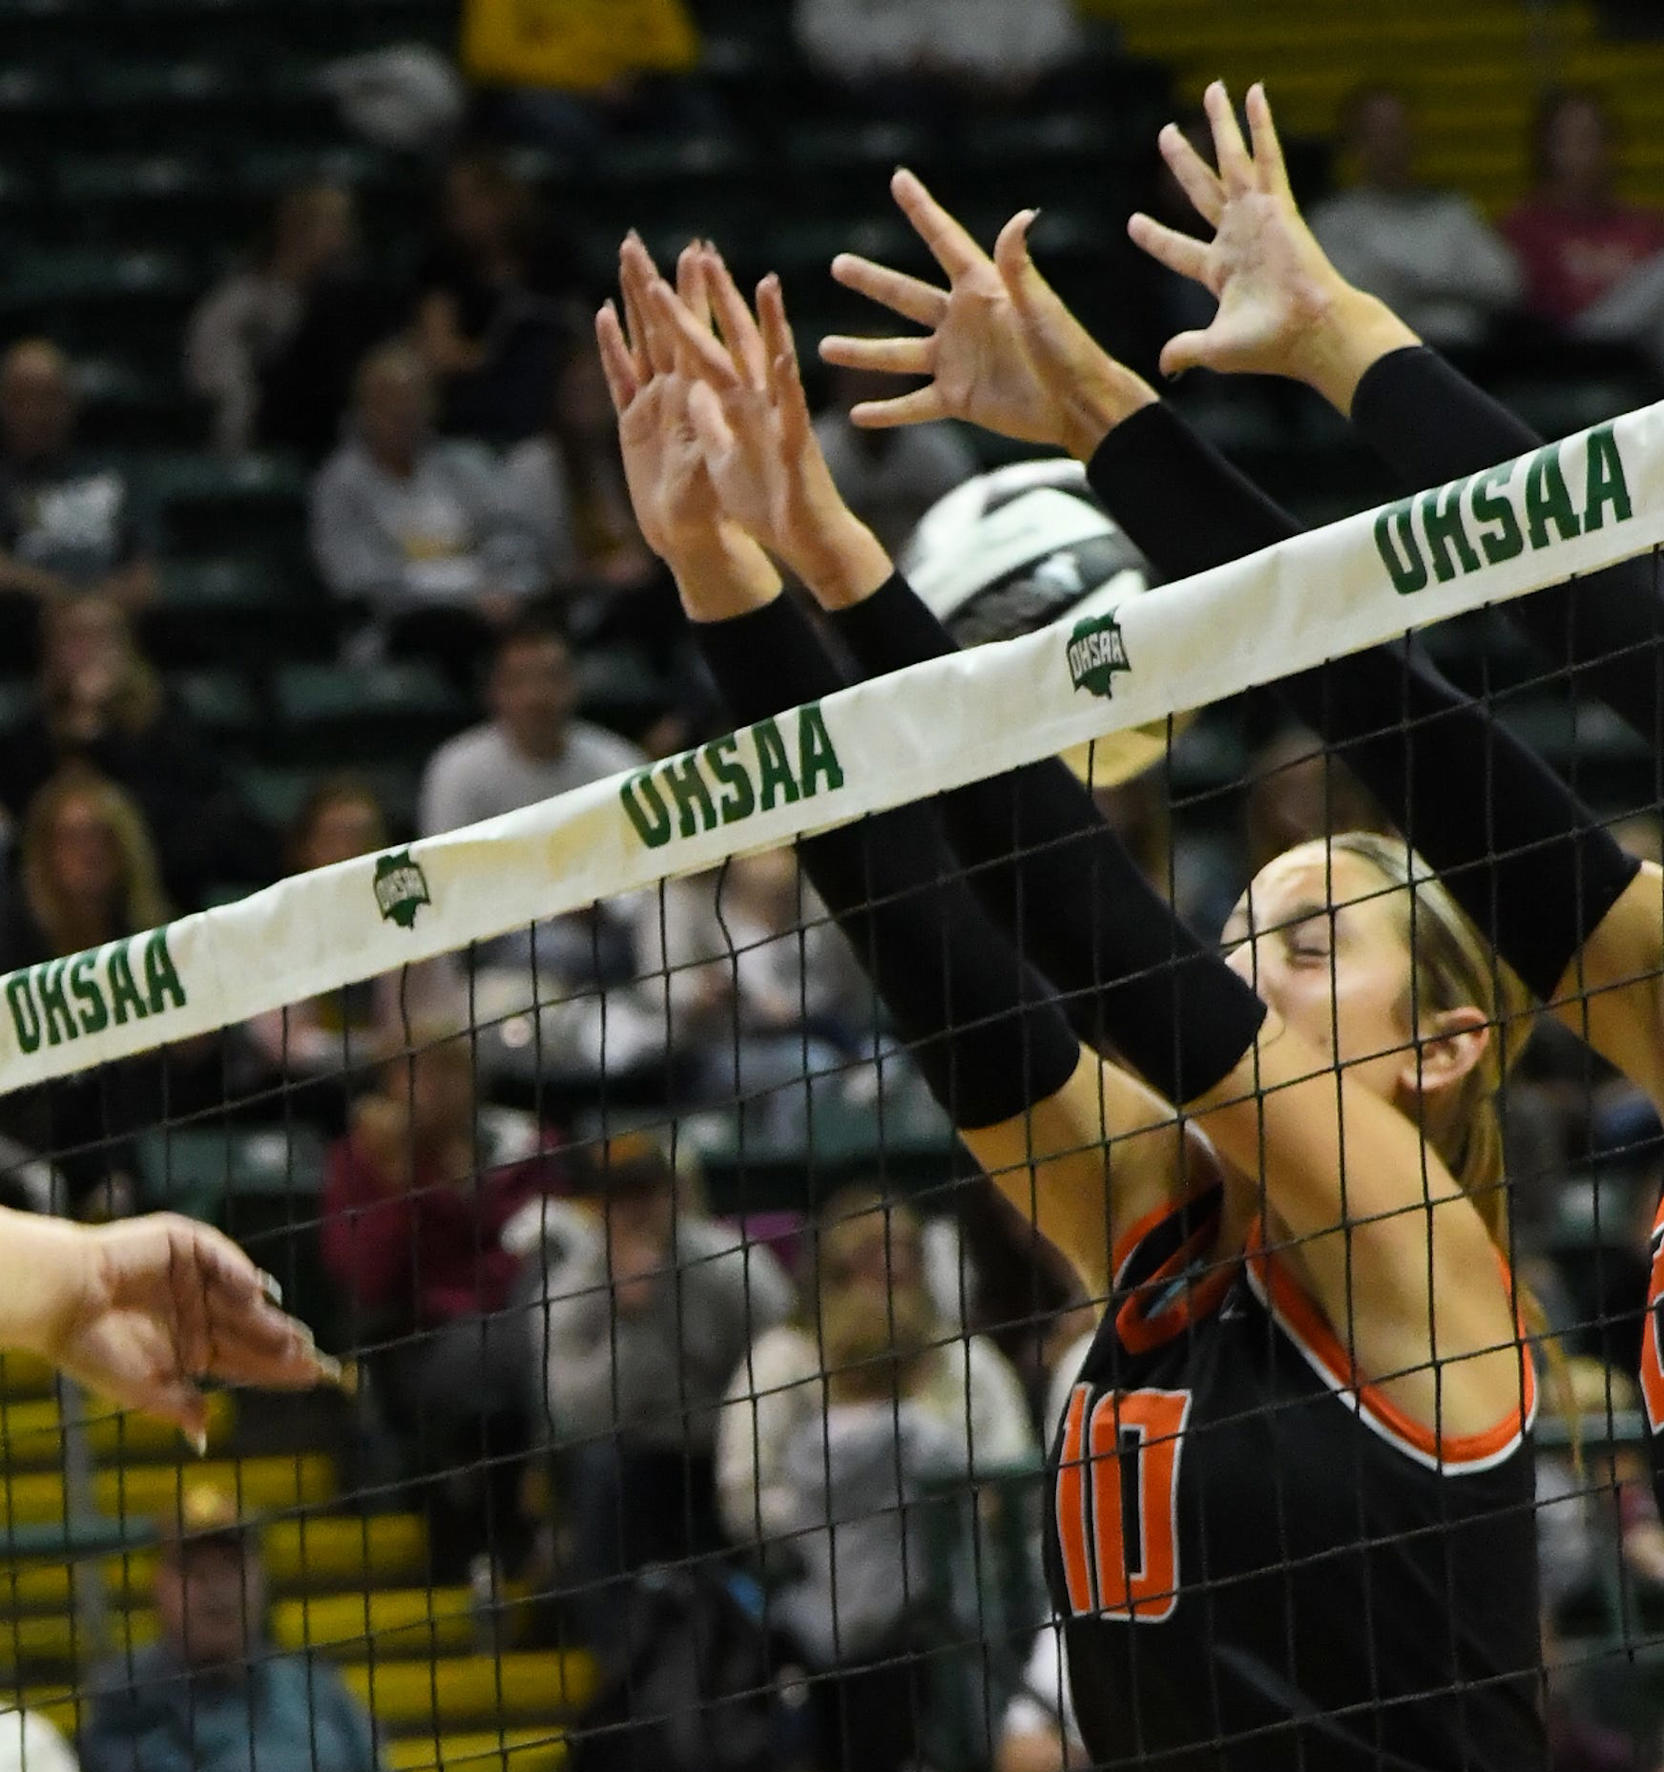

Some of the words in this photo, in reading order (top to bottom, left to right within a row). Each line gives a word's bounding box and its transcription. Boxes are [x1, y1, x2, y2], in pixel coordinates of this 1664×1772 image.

[1374, 424, 1632, 596] OHSAA
[1069, 629, 1126, 681] OHSAA
[619, 698, 844, 850] OHSAA
[6, 924, 187, 1055] OHSAA
[1055, 1382, 1192, 1622] 10
